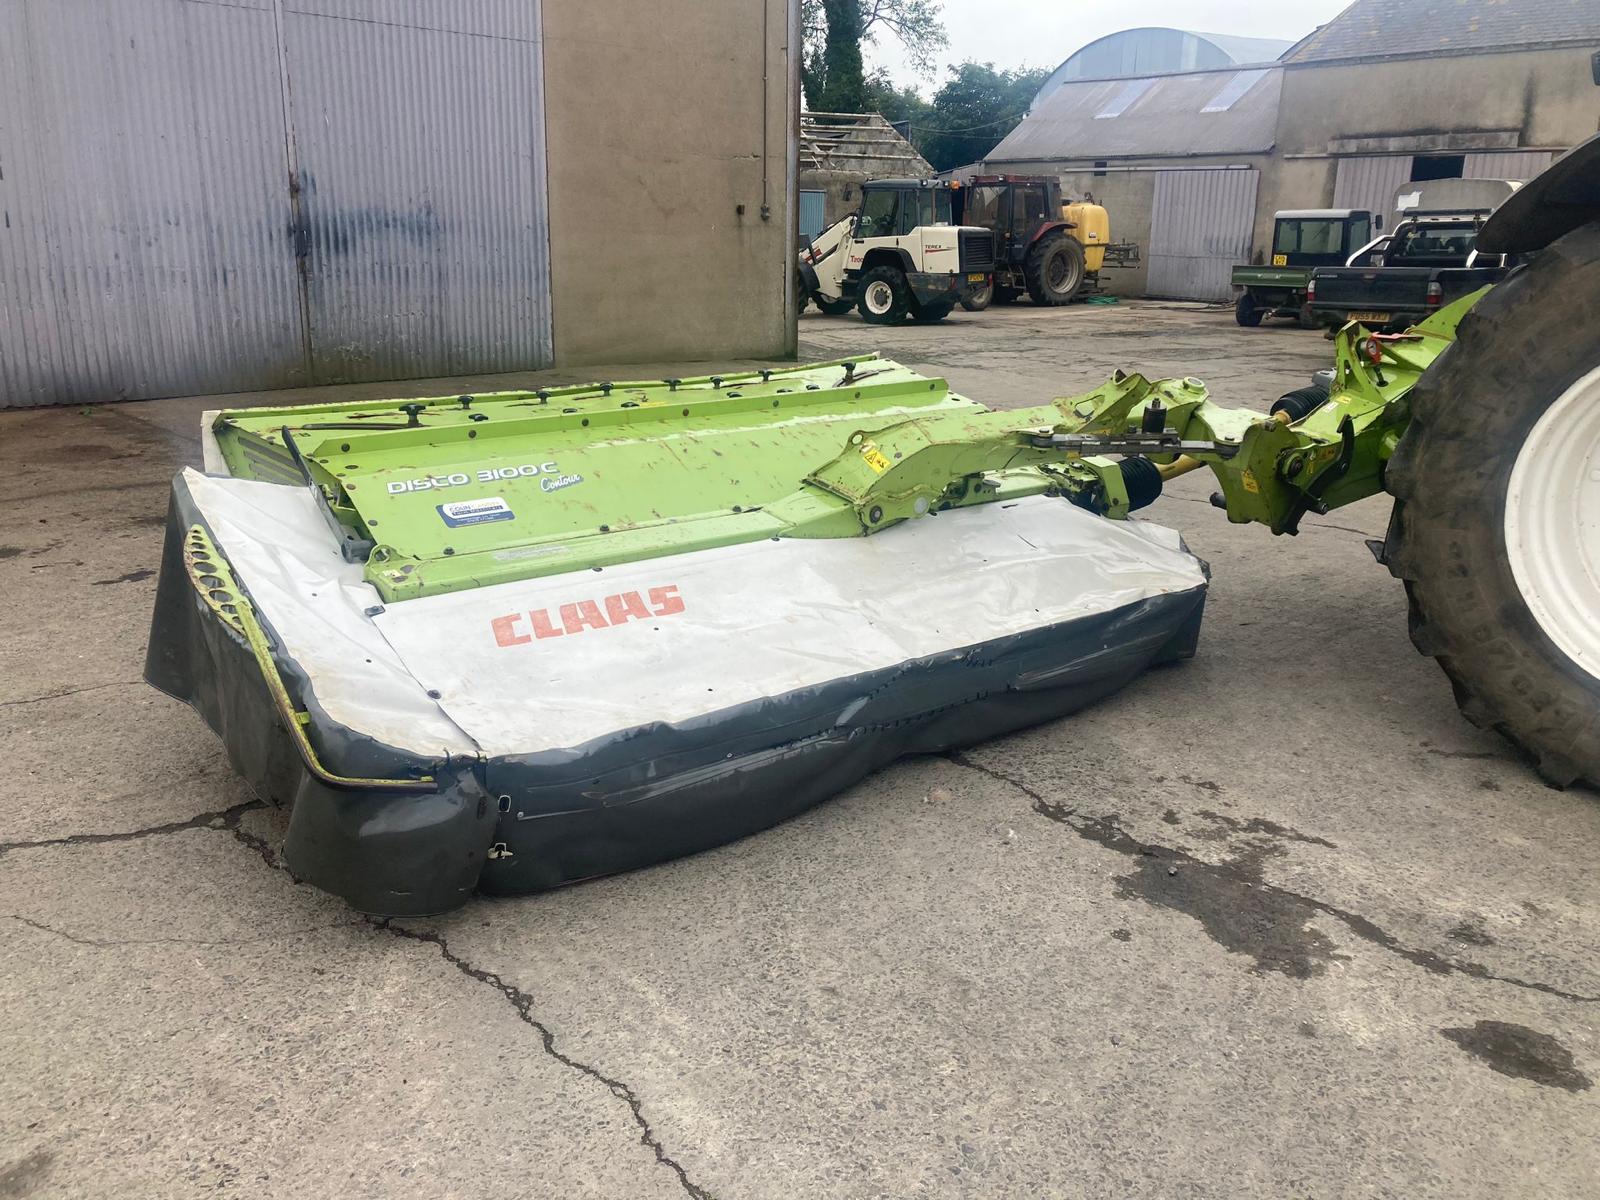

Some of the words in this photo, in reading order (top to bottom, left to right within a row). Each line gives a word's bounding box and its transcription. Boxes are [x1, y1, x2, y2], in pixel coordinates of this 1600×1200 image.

[387, 472, 470, 494] DISCO
[540, 473, 582, 492] Contour
[490, 584, 686, 648] CLAAS
